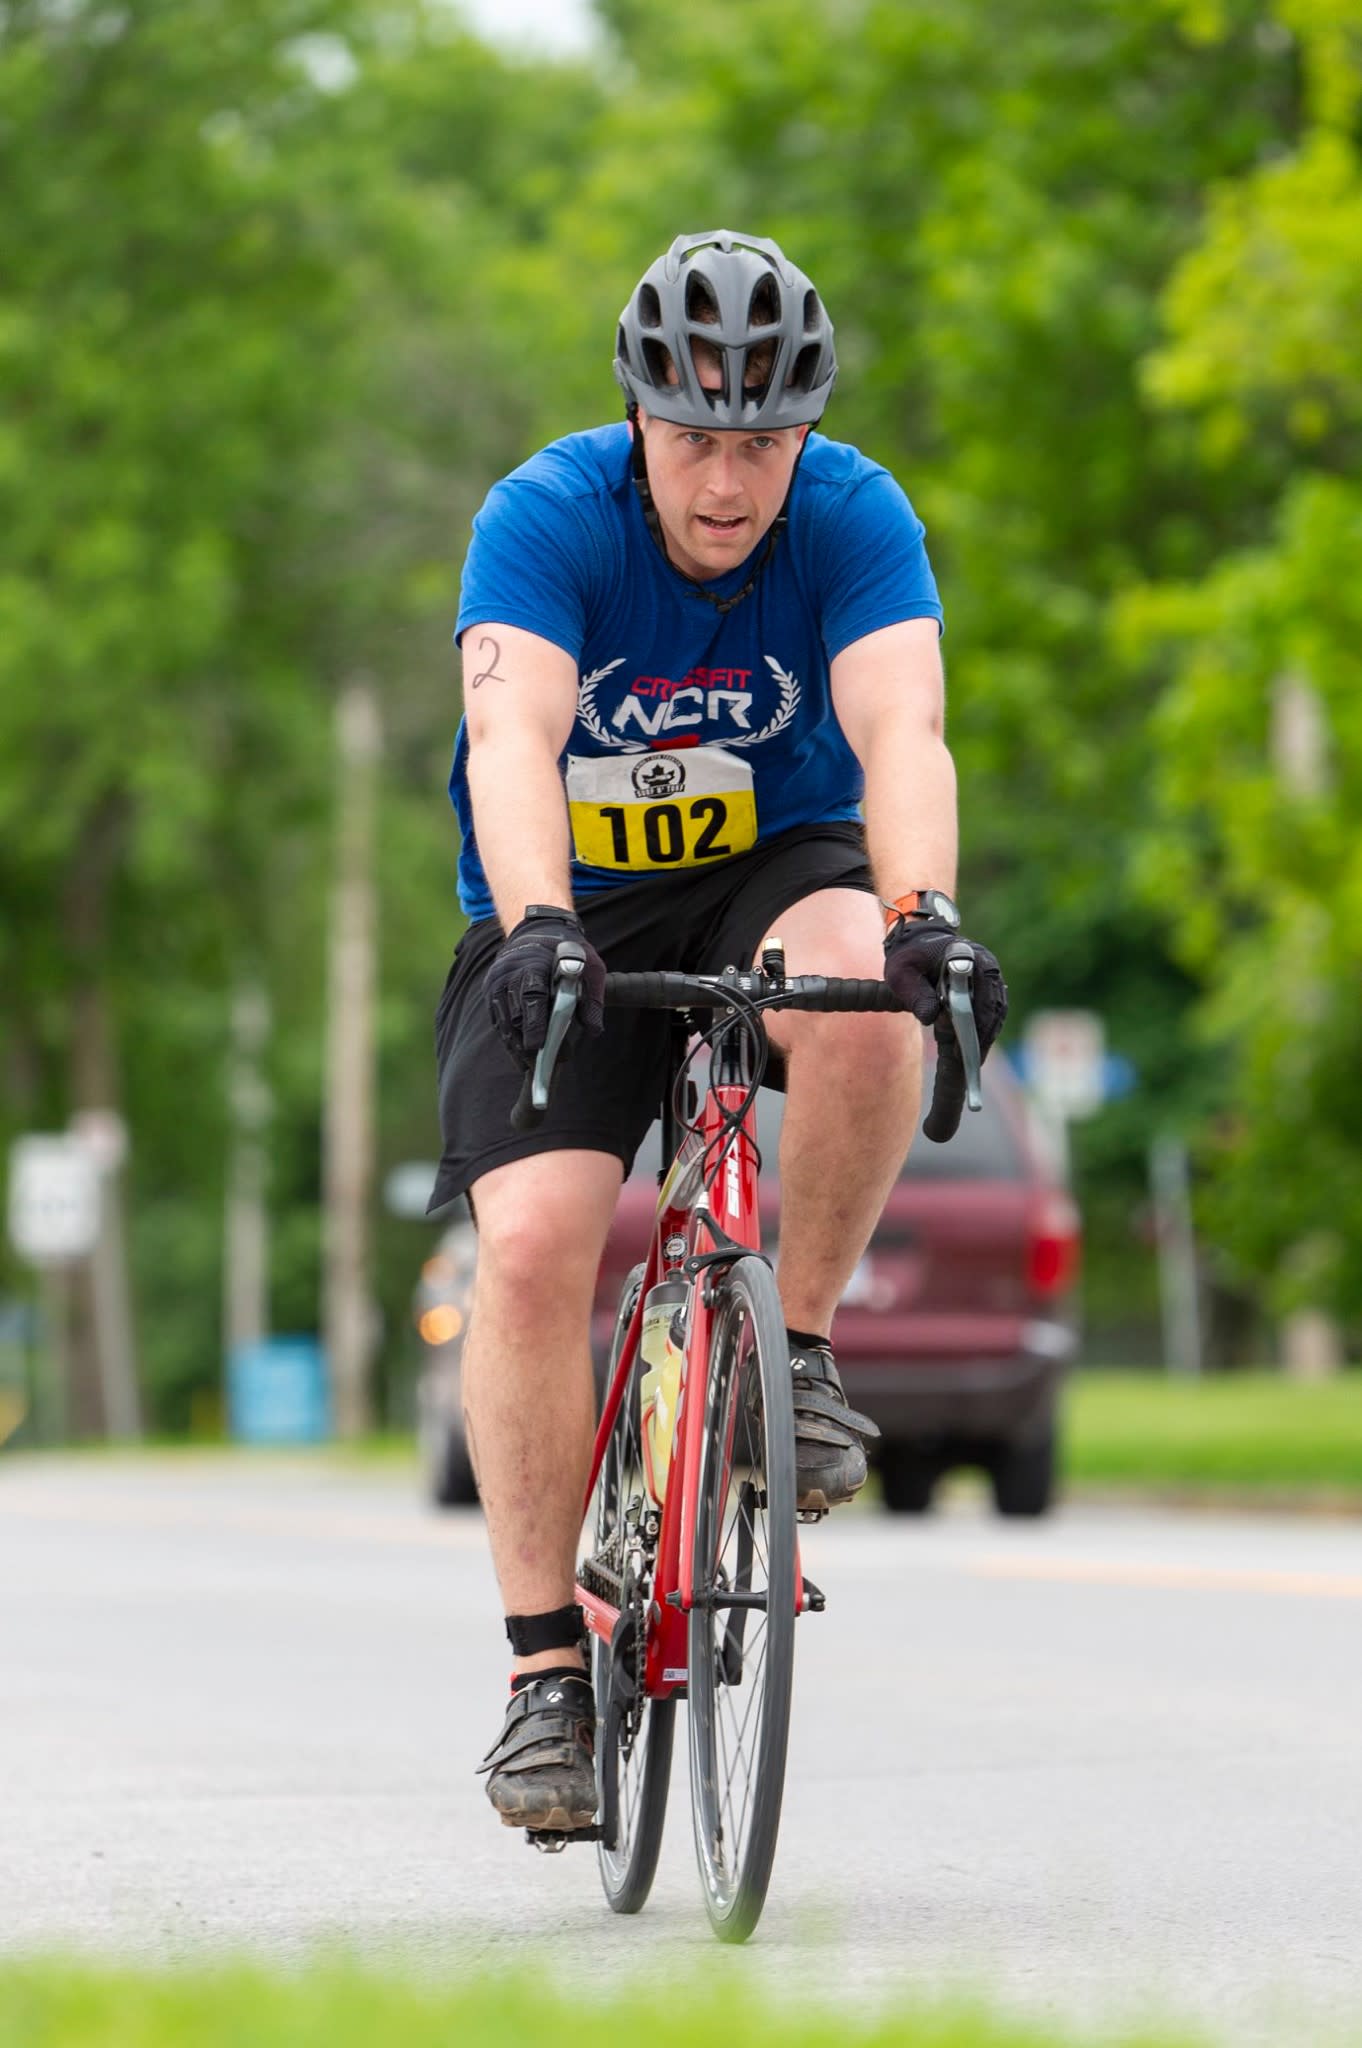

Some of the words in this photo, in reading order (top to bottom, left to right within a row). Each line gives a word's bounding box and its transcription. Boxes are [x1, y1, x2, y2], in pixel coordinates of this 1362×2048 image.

[472, 636, 506, 689] 2
[611, 687, 752, 736] NCR
[600, 797, 731, 863] 102
